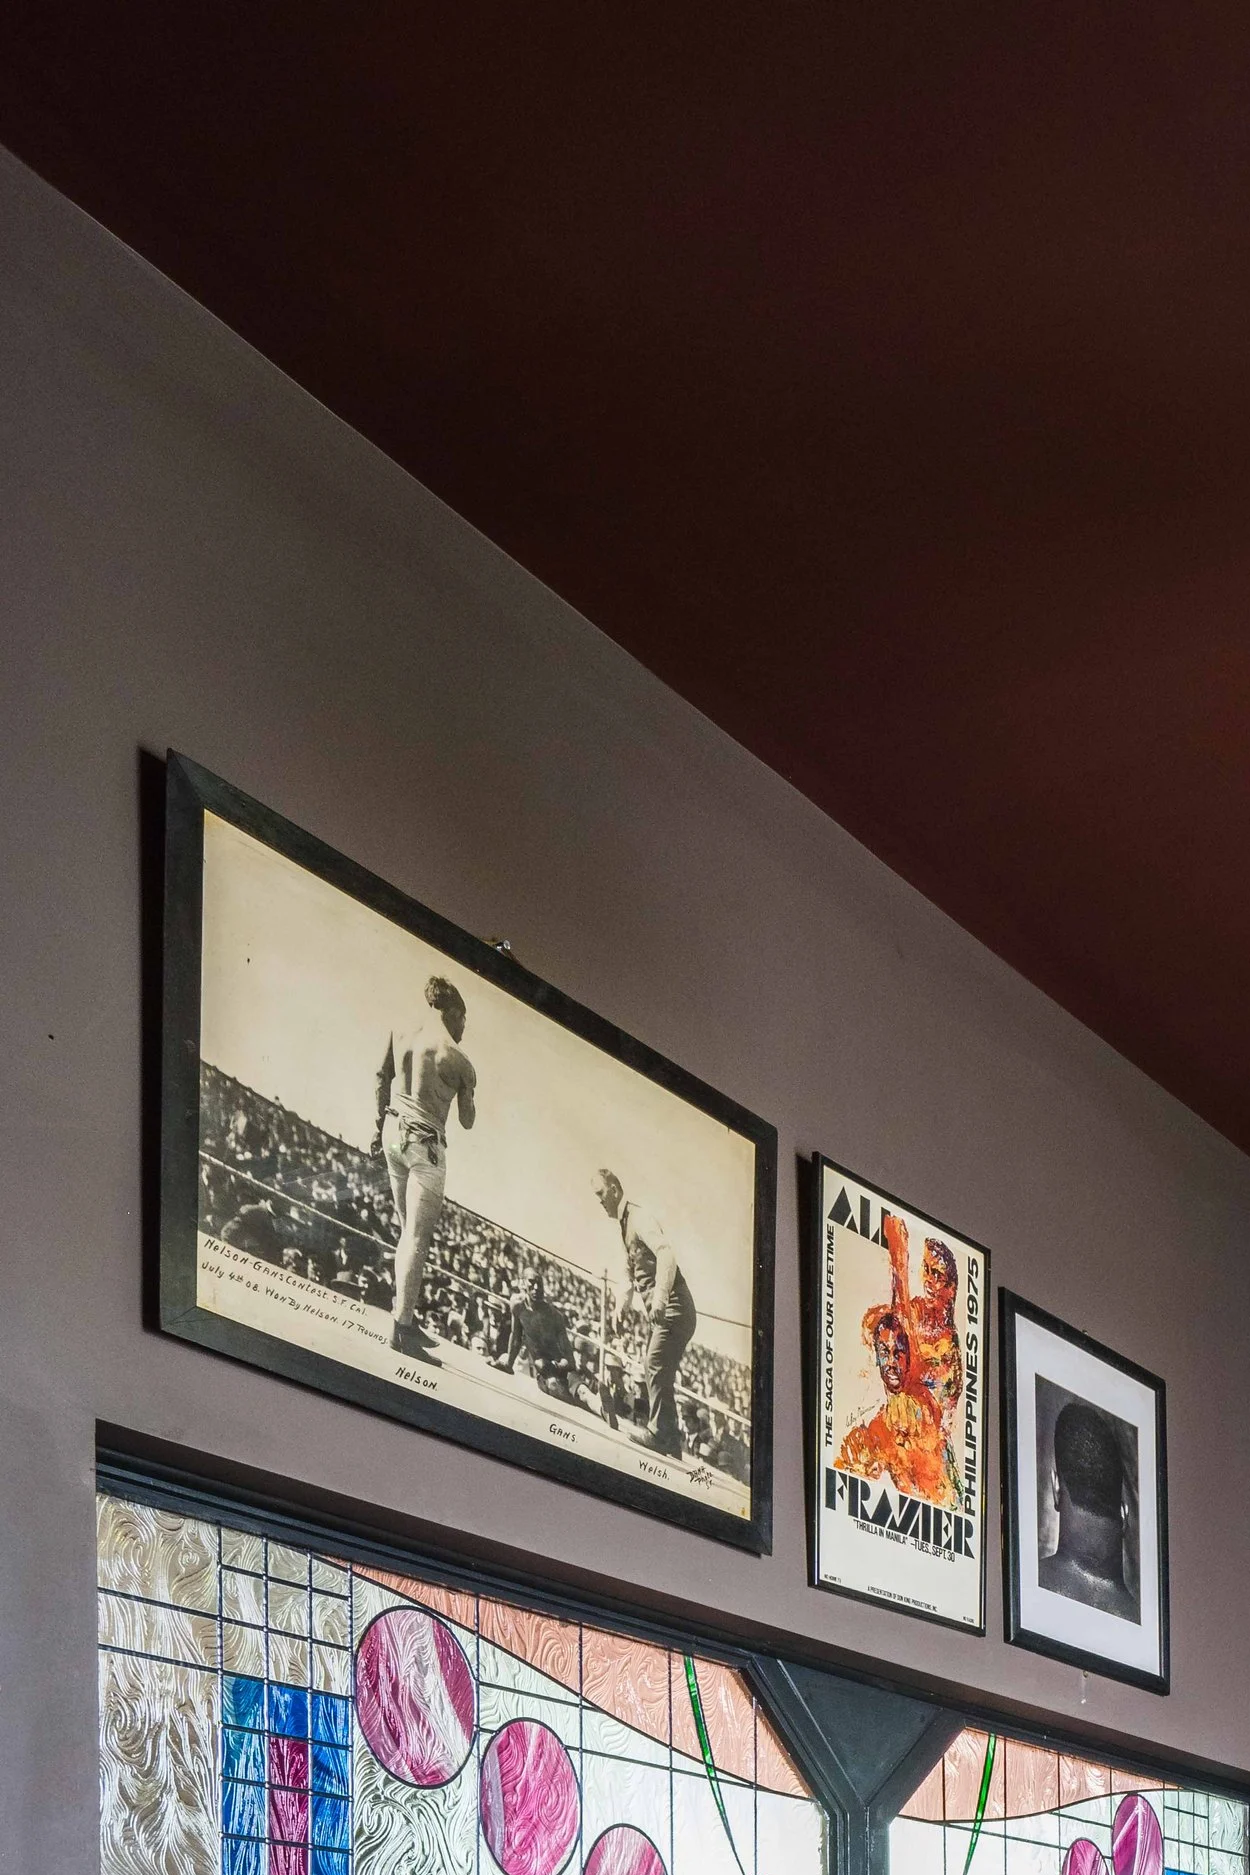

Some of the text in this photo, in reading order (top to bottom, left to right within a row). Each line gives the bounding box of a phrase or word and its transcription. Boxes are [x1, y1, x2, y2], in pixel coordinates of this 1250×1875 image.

[826, 1224, 834, 1298] LIFETIME
[202, 1261, 224, 1278] July
[342, 1319, 355, 1330] 17
[826, 1302, 834, 1339] OUR
[826, 1341, 834, 1364] OF
[826, 1367, 834, 1412] SAGA
[965, 1256, 979, 1516] PHILIPPINES 1975
[825, 1466, 975, 1559] FRAZIER
[879, 1525, 884, 1537] IN
[947, 1551, 956, 1563] 30
